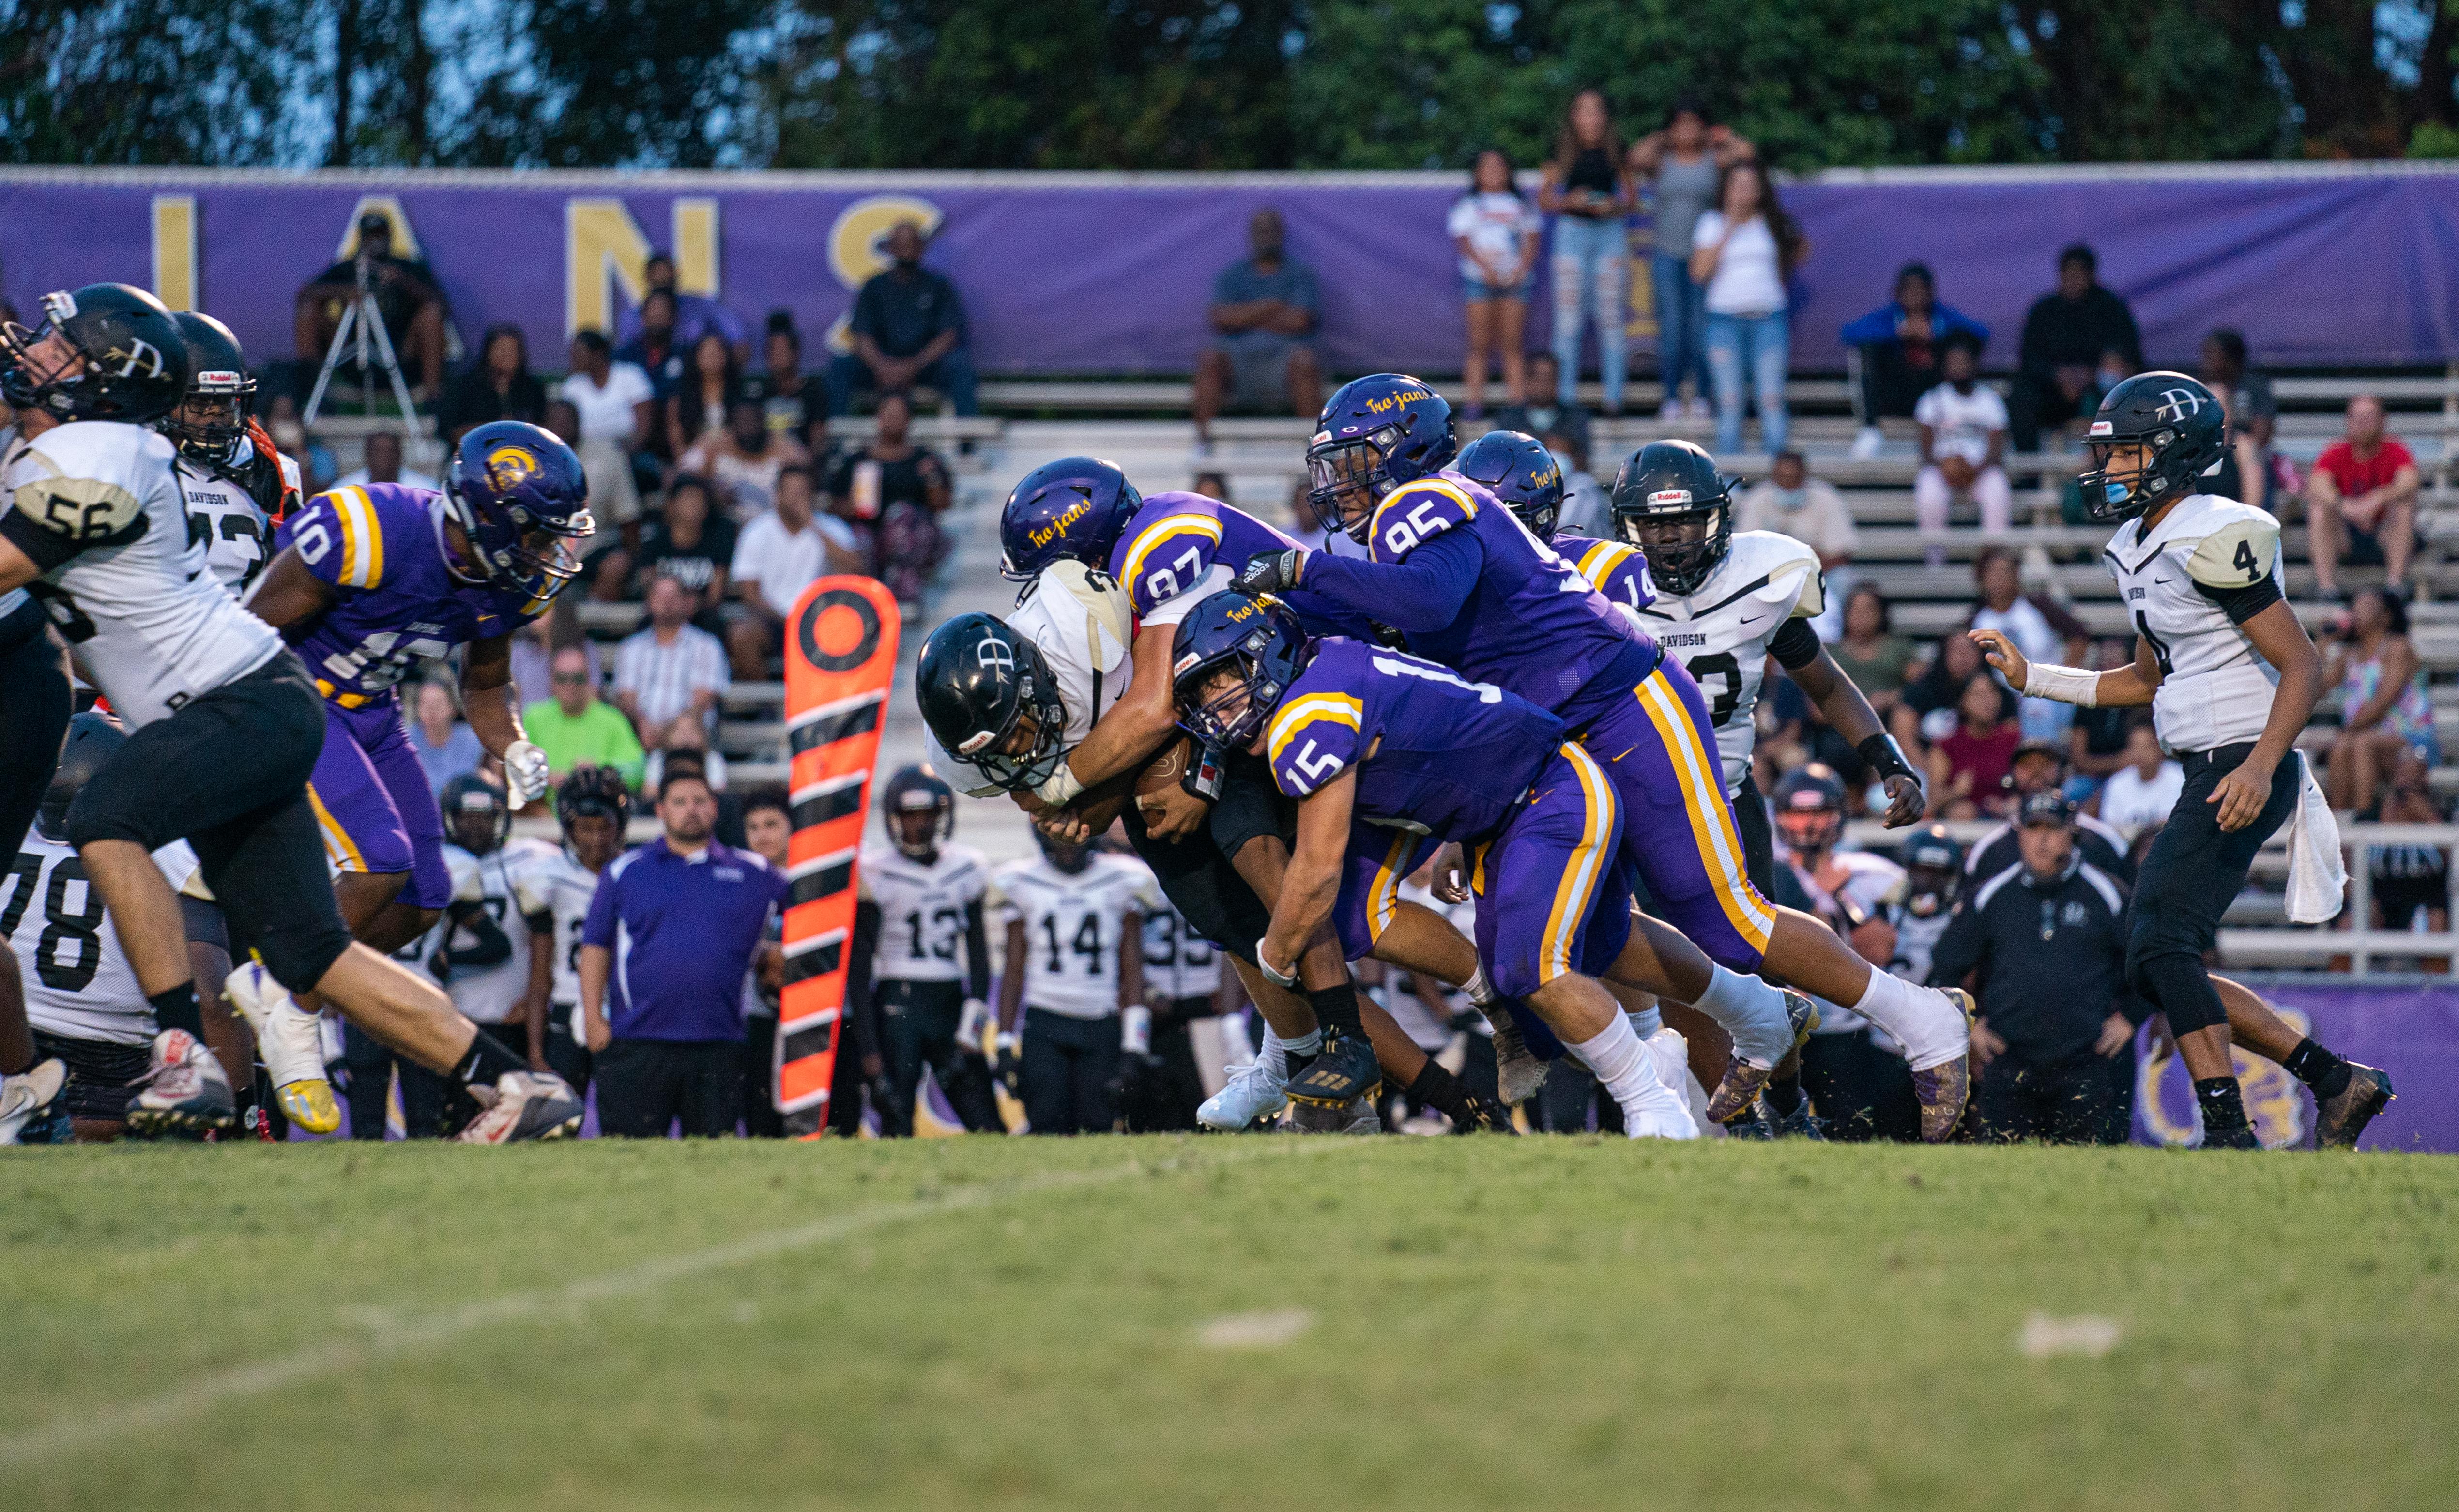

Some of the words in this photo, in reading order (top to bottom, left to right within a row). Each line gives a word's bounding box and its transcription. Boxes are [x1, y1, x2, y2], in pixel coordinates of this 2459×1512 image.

[1366, 390, 1428, 414] Trojans
[46, 493, 113, 541] 56
[188, 491, 229, 505] DAVIDSON
[1657, 491, 1681, 501] Riddell
[292, 505, 332, 565] 10
[1029, 499, 1091, 549] Trojans
[1385, 499, 1451, 554] 95
[1146, 545, 1202, 605] 97
[1243, 562, 1270, 584] adidas
[2232, 539, 2261, 582] 4
[1624, 567, 1659, 608] 14
[1660, 633, 1706, 647] DAVIDSON
[1285, 738, 1344, 795] 15
[0, 852, 103, 993] 78
[904, 909, 959, 959] 13
[1040, 912, 1103, 974] 14
